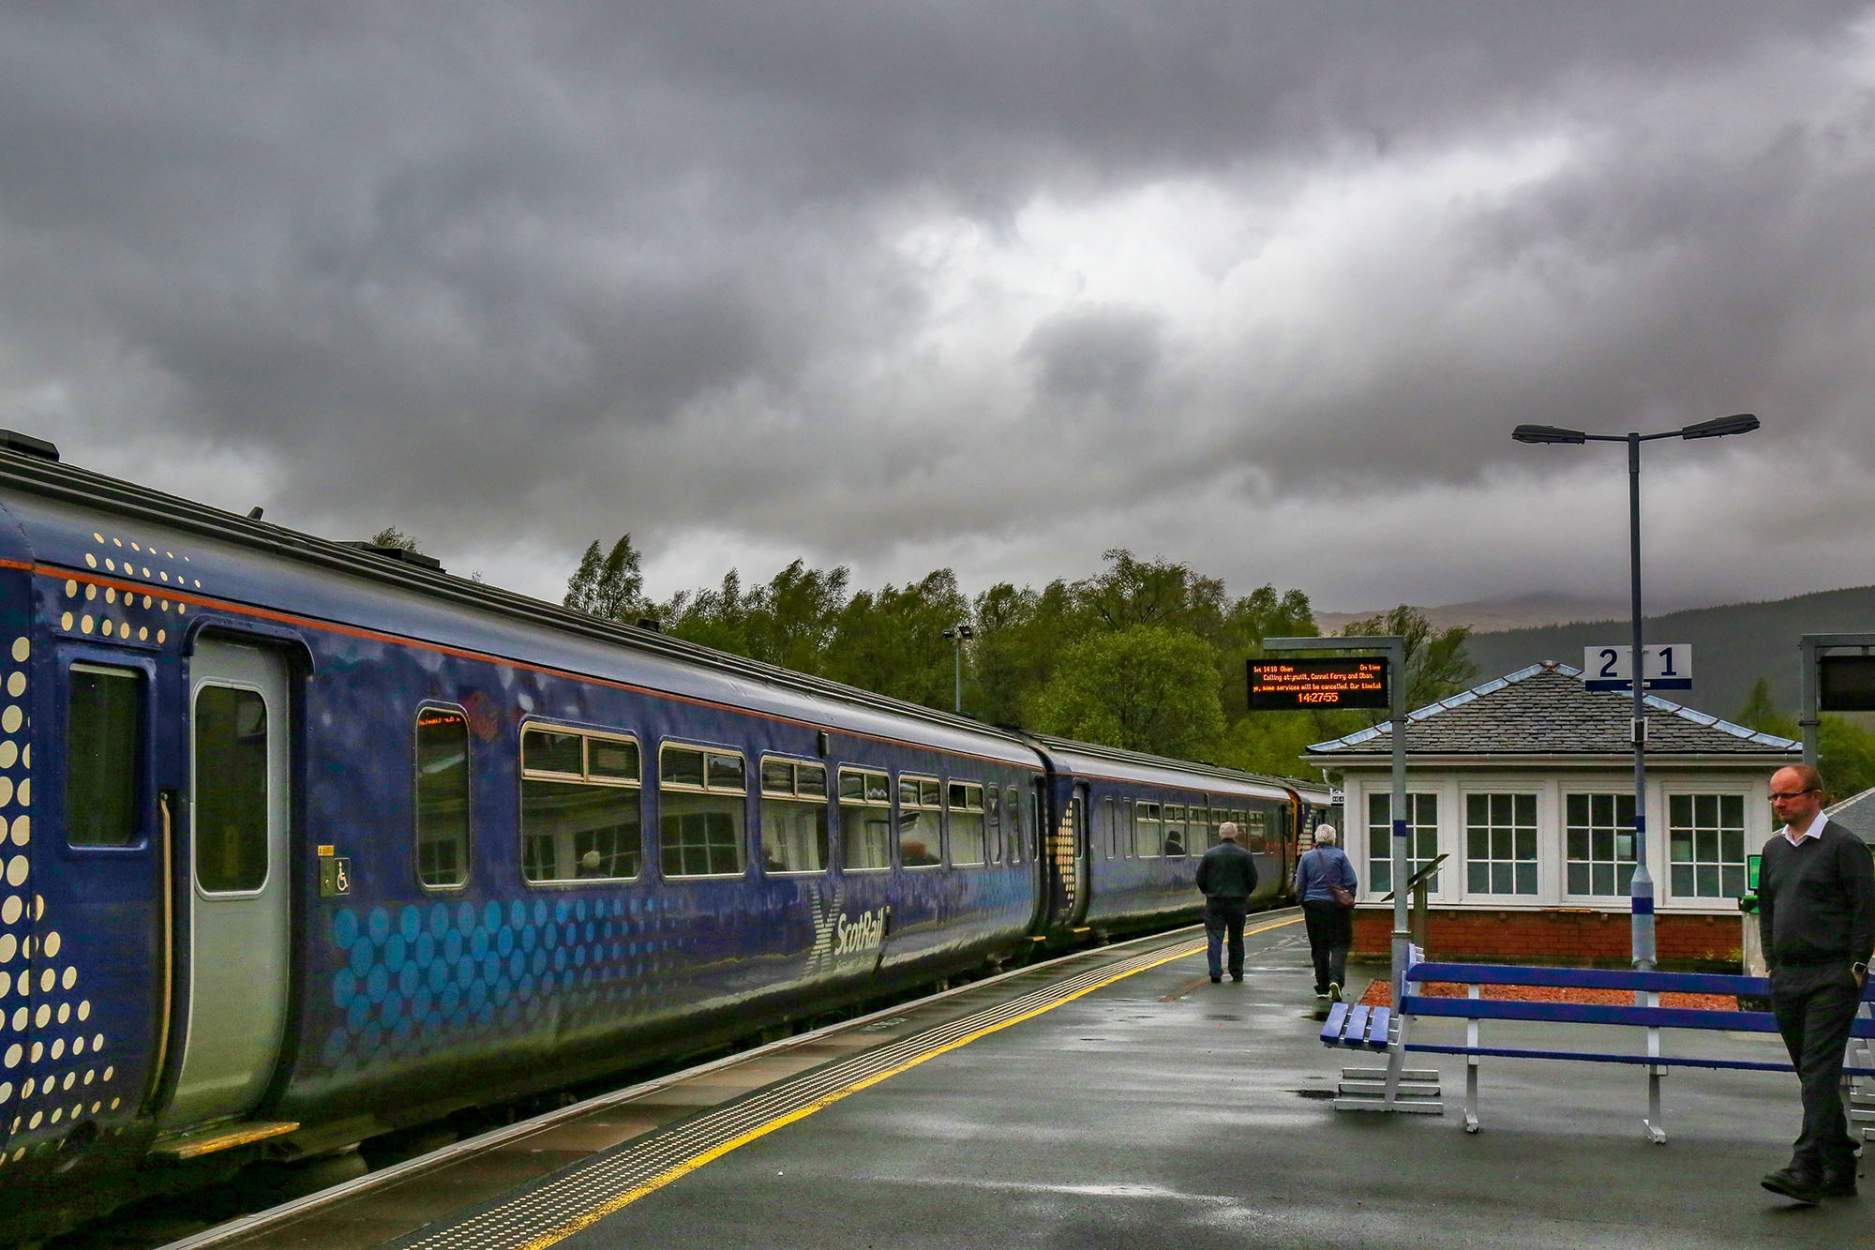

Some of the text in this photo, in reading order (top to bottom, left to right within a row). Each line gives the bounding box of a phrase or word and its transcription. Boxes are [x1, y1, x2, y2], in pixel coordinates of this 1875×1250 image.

[1600, 648, 1618, 677] 2
[1659, 647, 1677, 676] 1
[1263, 673, 1283, 682] Calling
[1348, 672, 1359, 680] and
[1298, 692, 1339, 703] 14:27:55
[834, 907, 884, 956] ScotRail
